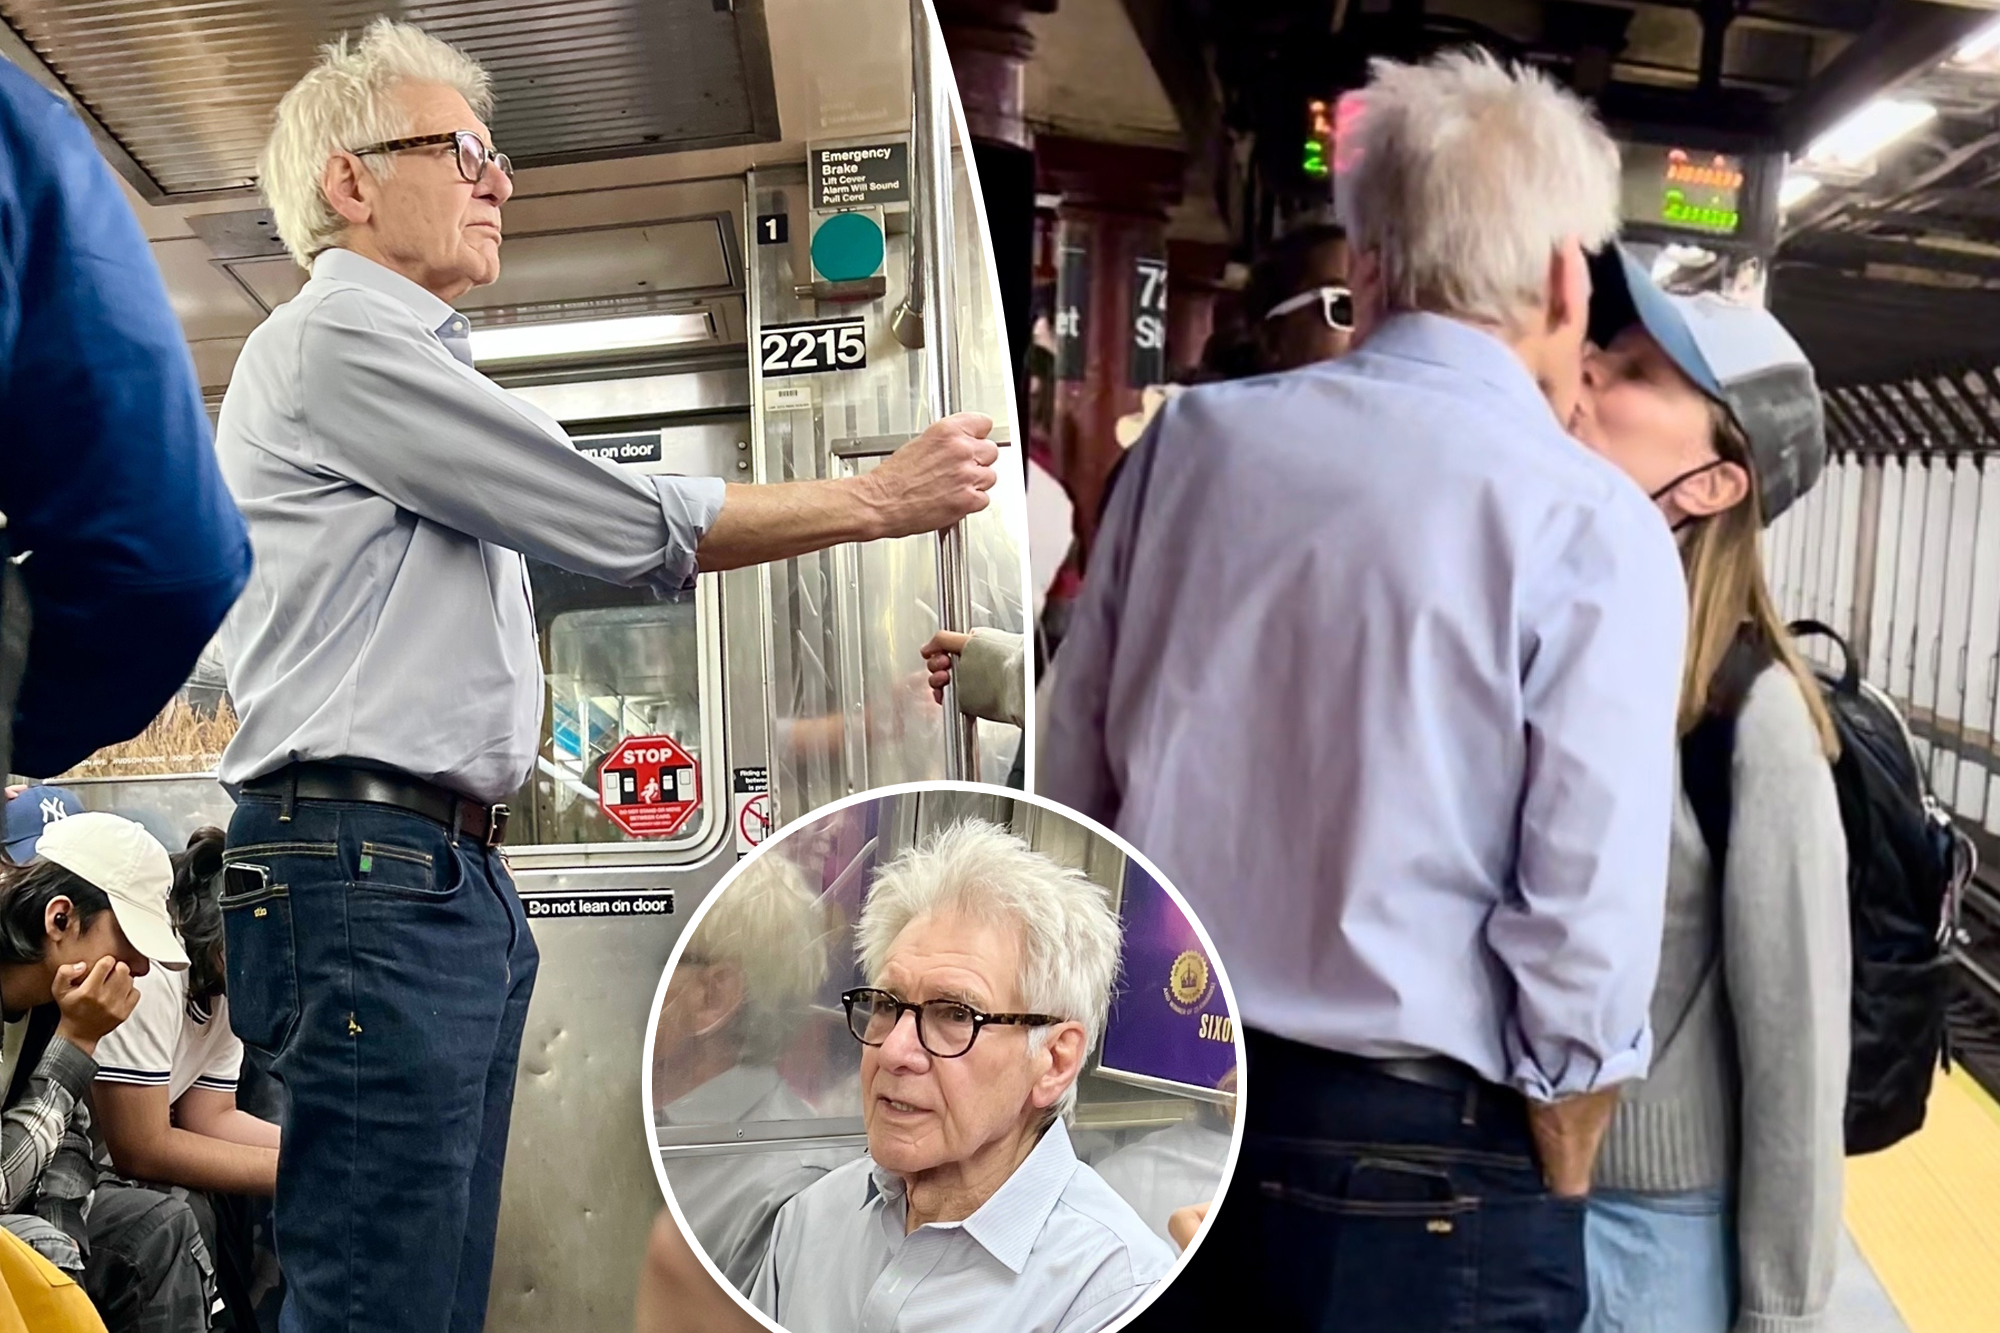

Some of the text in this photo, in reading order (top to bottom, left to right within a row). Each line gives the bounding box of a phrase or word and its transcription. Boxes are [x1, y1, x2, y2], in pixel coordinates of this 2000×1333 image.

[821, 147, 892, 163] Emergency
[822, 163, 859, 176] Brake
[822, 175, 867, 186] Lift Cover
[822, 180, 900, 195] Alarm Will Sound
[822, 193, 865, 204] Pull Cord
[765, 218, 777, 241] 1
[762, 326, 866, 371] 2215
[600, 446, 619, 458] on
[620, 443, 655, 457] door
[622, 747, 673, 765] STOP
[529, 898, 667, 915] Do not lean on door
